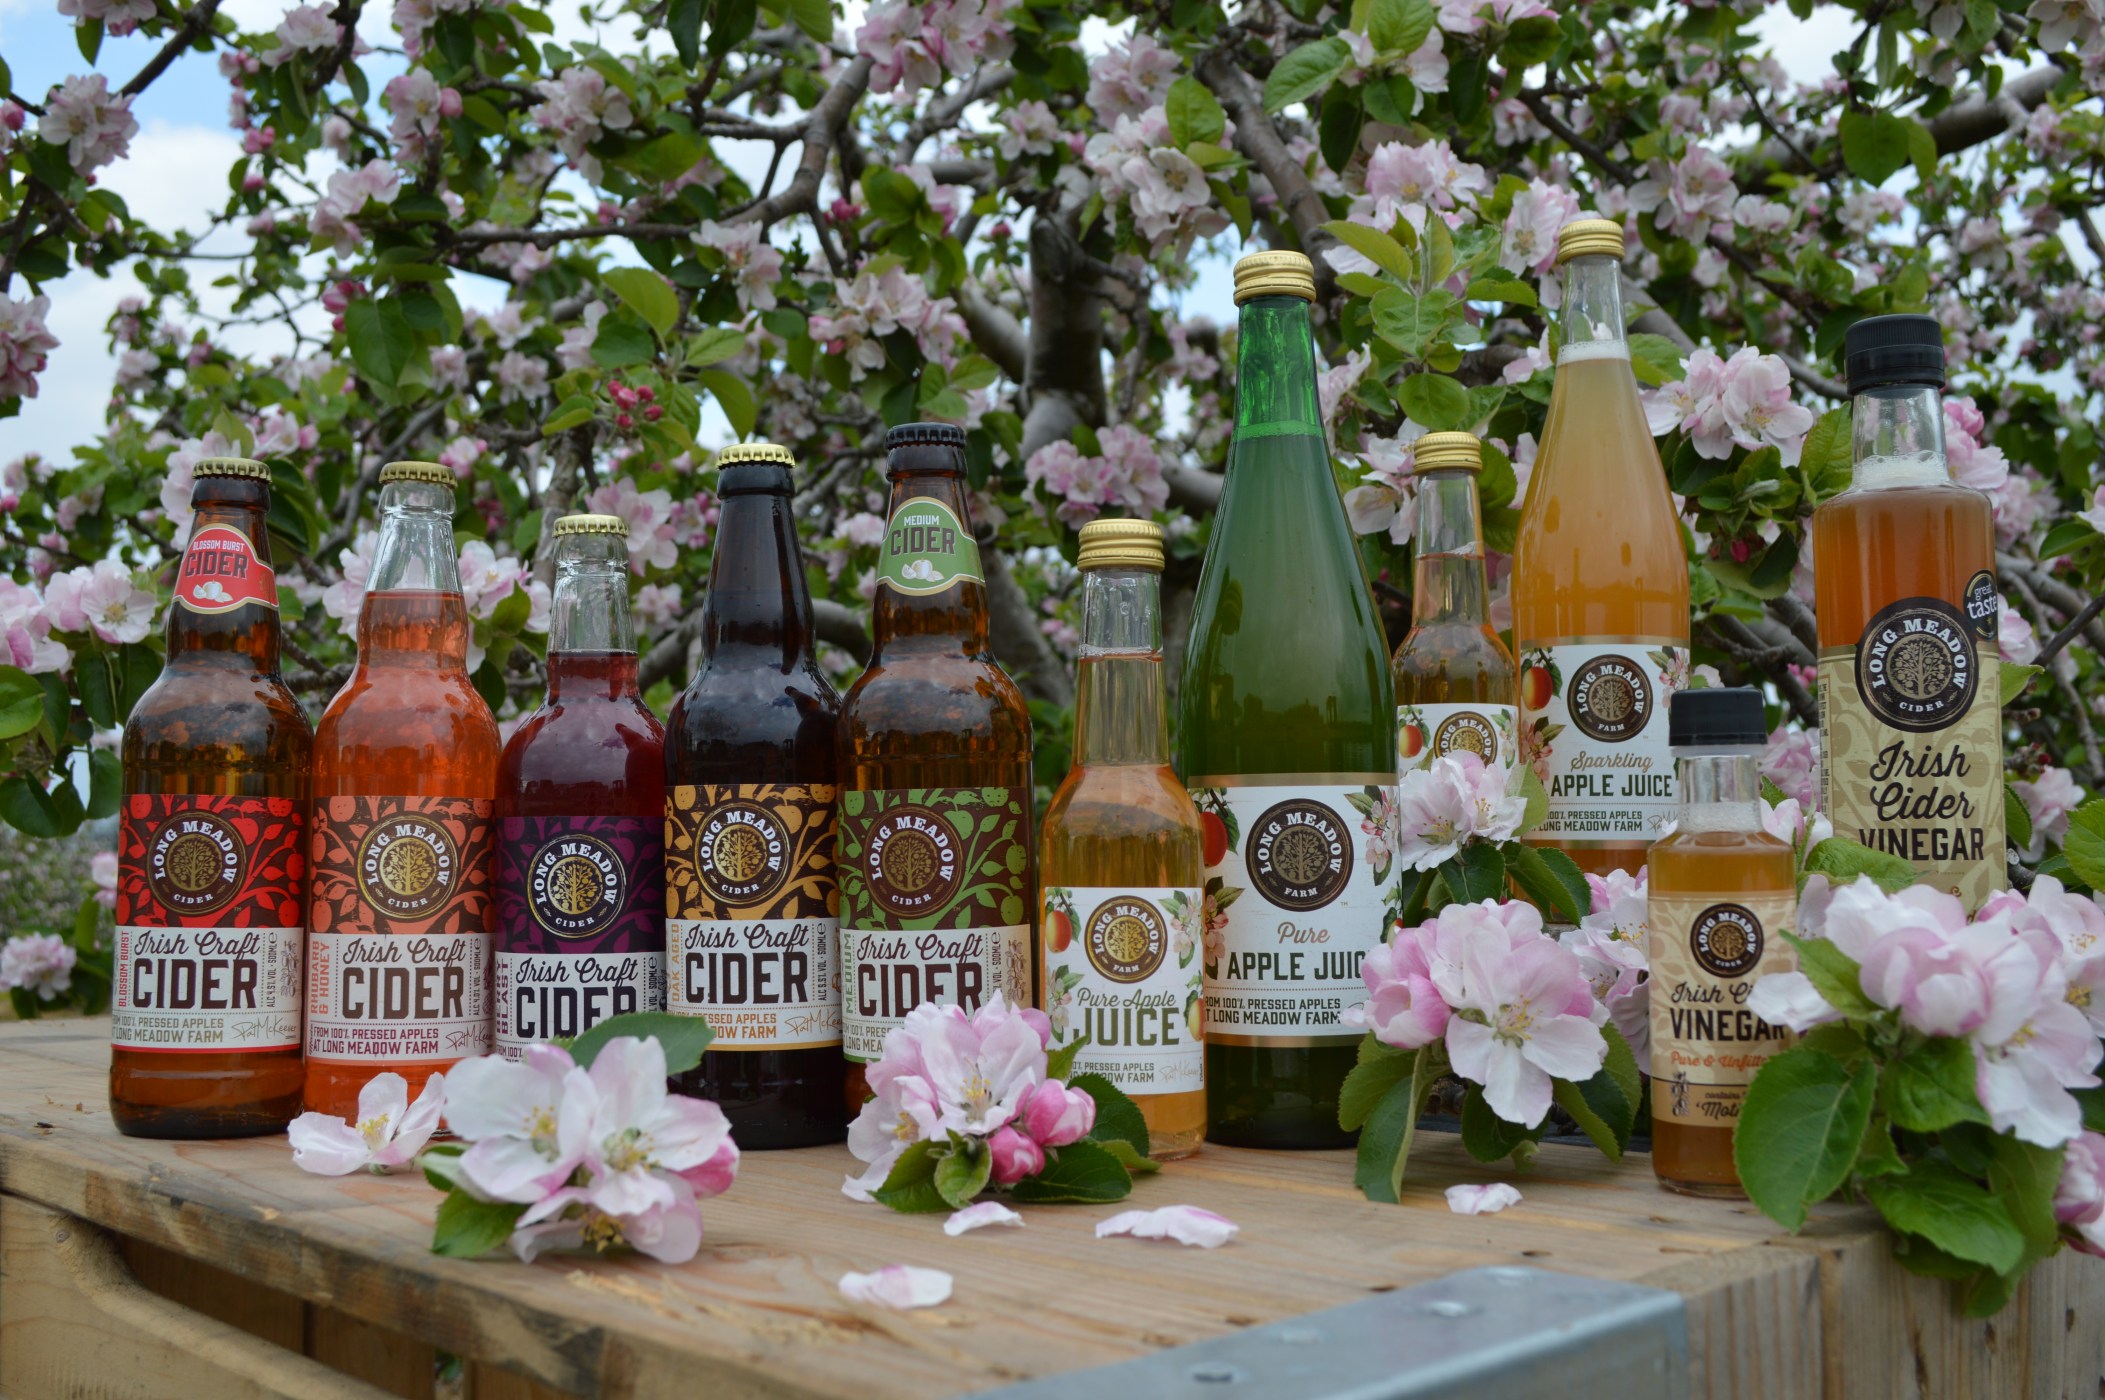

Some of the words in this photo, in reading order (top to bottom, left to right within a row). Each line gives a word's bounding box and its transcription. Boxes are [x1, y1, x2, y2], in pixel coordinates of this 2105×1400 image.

[904, 516, 940, 526] MEDIUM
[192, 540, 220, 550] BLOSSOM
[222, 540, 245, 552] BURST
[890, 527, 956, 556] CIDER
[185, 551, 248, 580] CIDER
[1975, 583, 1992, 601] great
[1967, 596, 1997, 619] taste
[1870, 628, 1899, 689] LONG
[1904, 618, 1967, 690] MEADOW
[1577, 672, 1596, 713] LONG
[1600, 665, 1644, 714] MEADOW
[1899, 700, 1945, 712] CIDER
[1458, 719, 1492, 756] MEADOW
[1598, 724, 1624, 732] FARM
[1571, 751, 1653, 773] Sparkling
[1870, 740, 1971, 781] Irish
[1551, 775, 1614, 797] APPLE
[1622, 775, 1672, 797] JUICE
[1870, 782, 1974, 821] Cider
[1564, 821, 1611, 831] MEADOW
[1614, 821, 1642, 831] FARM
[1568, 811, 1606, 819] PRESSED
[1610, 811, 1642, 819] APPLES
[154, 828, 178, 880] LONG
[182, 820, 238, 883] MEADOW
[701, 820, 722, 872] LONG
[726, 811, 781, 872] MEADOW
[870, 825, 892, 880] LONG
[896, 816, 954, 881] MEADOW
[1258, 822, 1281, 874] LONG
[1286, 812, 1342, 873] MEADOW
[1859, 828, 1984, 860] VINEGAR
[366, 832, 390, 885] LONG
[395, 824, 450, 886] MEADOW
[534, 852, 557, 905] LONG
[561, 842, 617, 904] MEADOW
[174, 893, 214, 904] CIDER
[722, 883, 759, 894] CIDER
[892, 894, 932, 905] CIDER
[1284, 887, 1318, 897] FARM
[388, 898, 428, 908] CIDER
[555, 917, 595, 928] CIDER
[1093, 913, 1113, 955] LONG
[1116, 906, 1159, 954] MEADOW
[1277, 921, 1330, 944] Pure
[1698, 919, 1716, 952] LONG
[1718, 912, 1756, 953] MEADOW
[121, 930, 129, 960] BURST
[134, 930, 189, 956] Irish
[194, 930, 260, 960] Craft
[685, 924, 739, 949] Irish
[744, 923, 810, 953] Craft
[857, 934, 911, 960] Irish
[916, 934, 984, 964] Craft
[343, 938, 407, 965] Irish
[407, 938, 466, 968] Craft
[268, 968, 276, 980] VOL
[320, 942, 329, 997] HONEY
[516, 958, 570, 984] Irish
[574, 958, 638, 987] Craft
[818, 961, 826, 970] VOL
[844, 933, 853, 1014] MEDIUM
[993, 971, 1001, 982] VOL
[1113, 964, 1139, 973] FARM
[1227, 952, 1305, 980] APPLE
[1314, 951, 1367, 979] JUIC
[118, 964, 128, 1007] BLOSSOM
[133, 958, 258, 1009] CIDER
[311, 941, 319, 1014] RHUBARB
[685, 952, 808, 1004] CIDER
[342, 966, 464, 1019] CIDER
[818, 991, 826, 1000] ALC
[858, 962, 983, 1018] CIDER
[1077, 988, 1120, 1007] Pure
[1123, 988, 1176, 1010] Apple
[1671, 981, 1724, 1005] Irish
[266, 996, 275, 1008] ALC
[319, 1004, 329, 1015] &
[516, 985, 637, 1039] CIDER
[649, 995, 657, 1009] VOL
[1223, 998, 1245, 1009] 100%
[1248, 999, 1296, 1010] PRESSED
[1299, 999, 1341, 1010] APPLES
[138, 1016, 179, 1029] PRESSED
[182, 1018, 224, 1029] APPLES
[736, 1014, 776, 1024] APPLES
[1073, 1008, 1180, 1046] JUICE
[1214, 1010, 1239, 1023] LONG
[1244, 1012, 1302, 1024] MEADOW
[1306, 1012, 1341, 1024] FARM
[116, 1028, 131, 1041] LONG
[134, 1029, 183, 1042] MEADOW
[188, 1030, 223, 1042] FARM
[314, 1026, 330, 1039] FROM
[331, 1028, 349, 1039] 100%
[352, 1028, 396, 1040] PRESSED
[400, 1028, 438, 1039] APPLES
[742, 1026, 776, 1038] FARM
[314, 1040, 321, 1051] AT
[322, 1041, 344, 1053] LONG
[348, 1041, 401, 1054] MEADOW
[405, 1041, 438, 1054] FARM
[863, 1040, 883, 1053] MEA
[1084, 1063, 1120, 1071] PRESSED
[1123, 1063, 1154, 1071] APPLES
[1670, 1051, 1700, 1066] Pure
[1704, 1054, 1714, 1067] &
[1128, 1073, 1154, 1082] FARM
